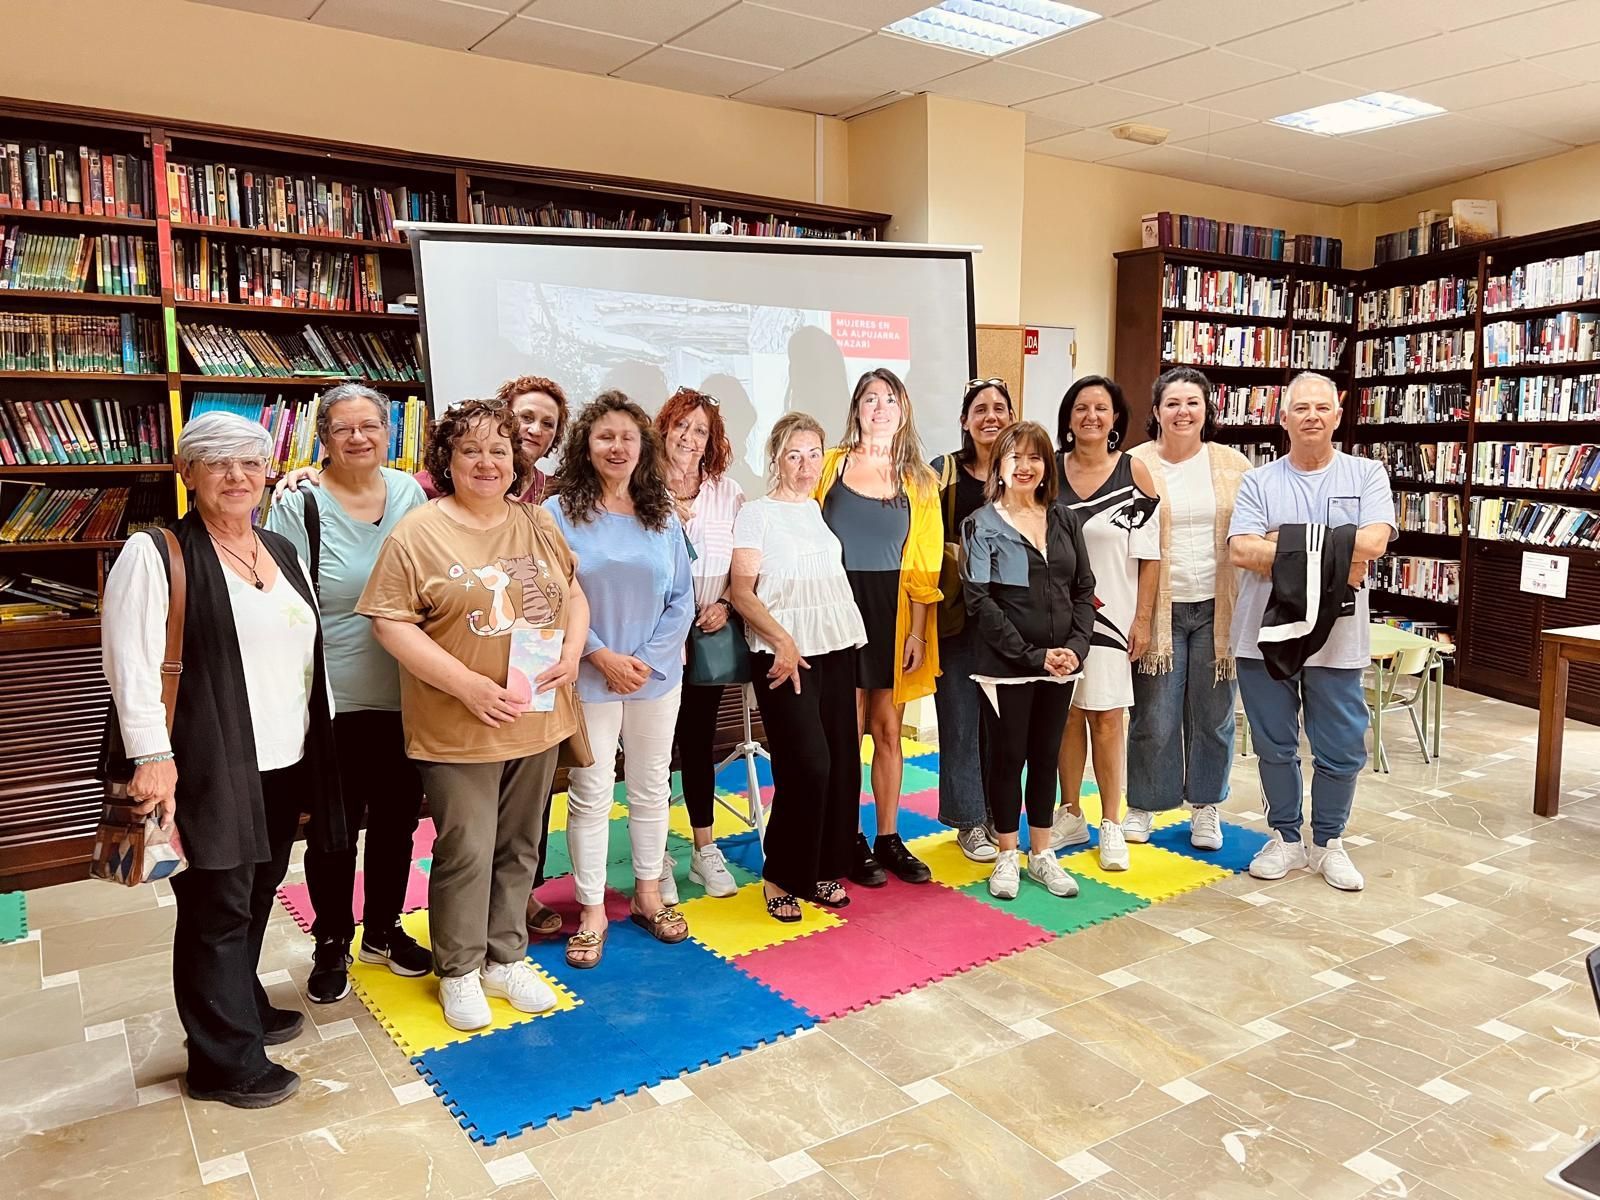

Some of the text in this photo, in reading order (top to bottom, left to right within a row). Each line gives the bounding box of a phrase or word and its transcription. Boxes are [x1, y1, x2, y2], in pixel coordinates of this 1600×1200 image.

[836, 319, 891, 330] MUJERES EN
[836, 329, 900, 340] LA ALPUJARRA
